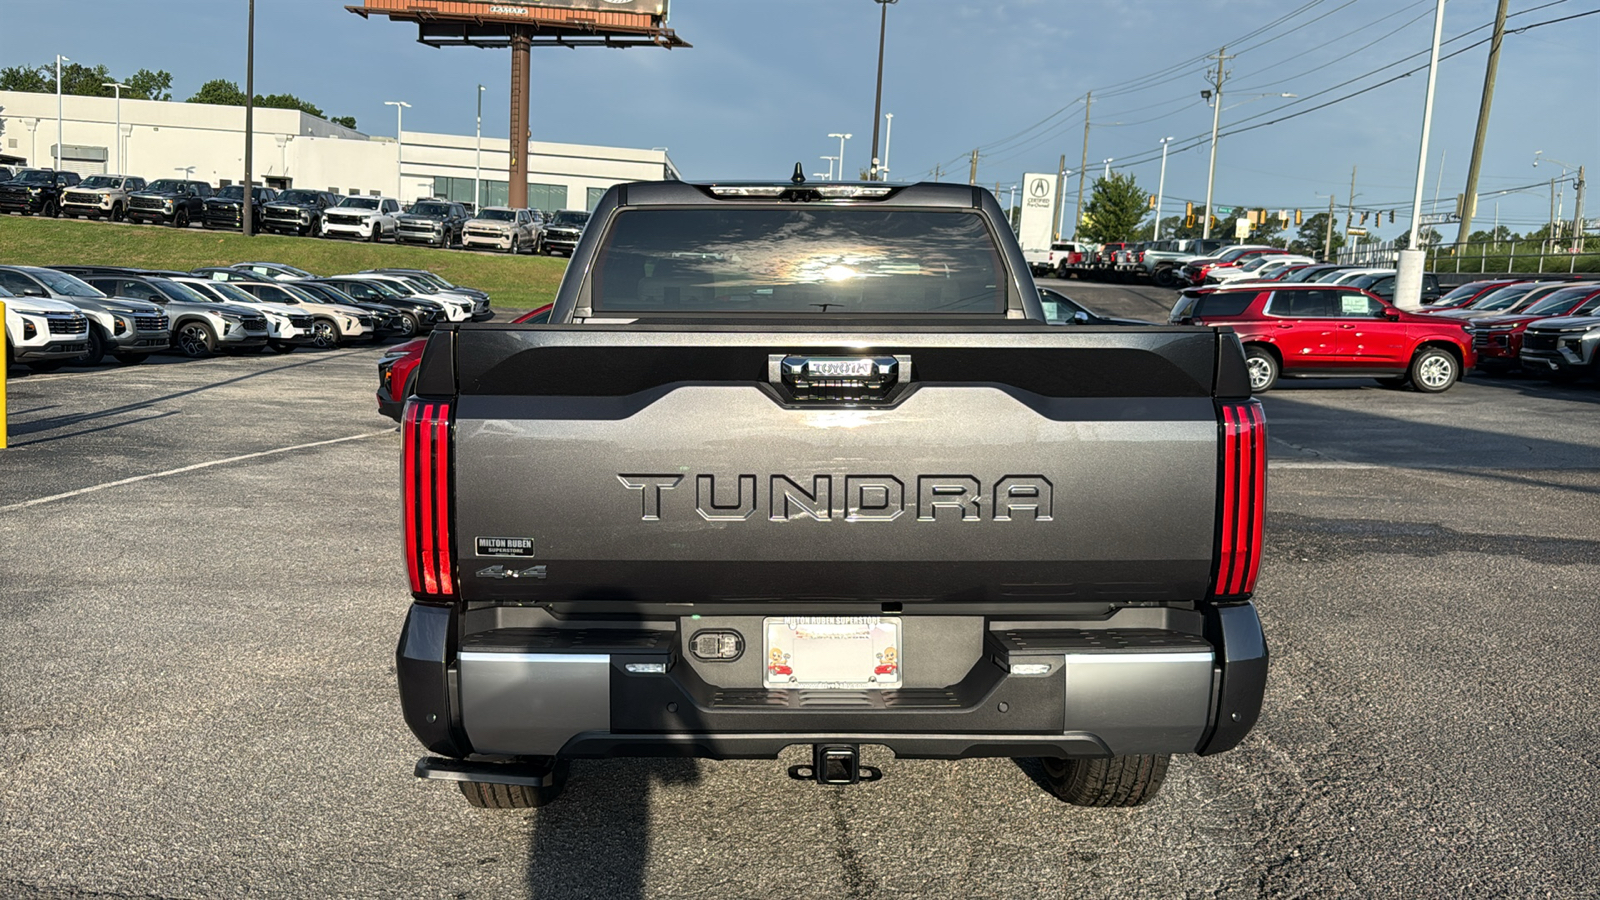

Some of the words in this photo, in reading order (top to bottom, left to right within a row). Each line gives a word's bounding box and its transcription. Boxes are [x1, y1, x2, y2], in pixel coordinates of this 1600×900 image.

[812, 362, 869, 373] TOYOTA
[616, 474, 1054, 522] TUNDRA
[479, 539, 506, 548] MILTON
[507, 539, 532, 548] RUBEN
[784, 616, 810, 624] MILTON
[811, 616, 835, 624] RUBEN
[836, 616, 881, 625] SUPERSTORE
